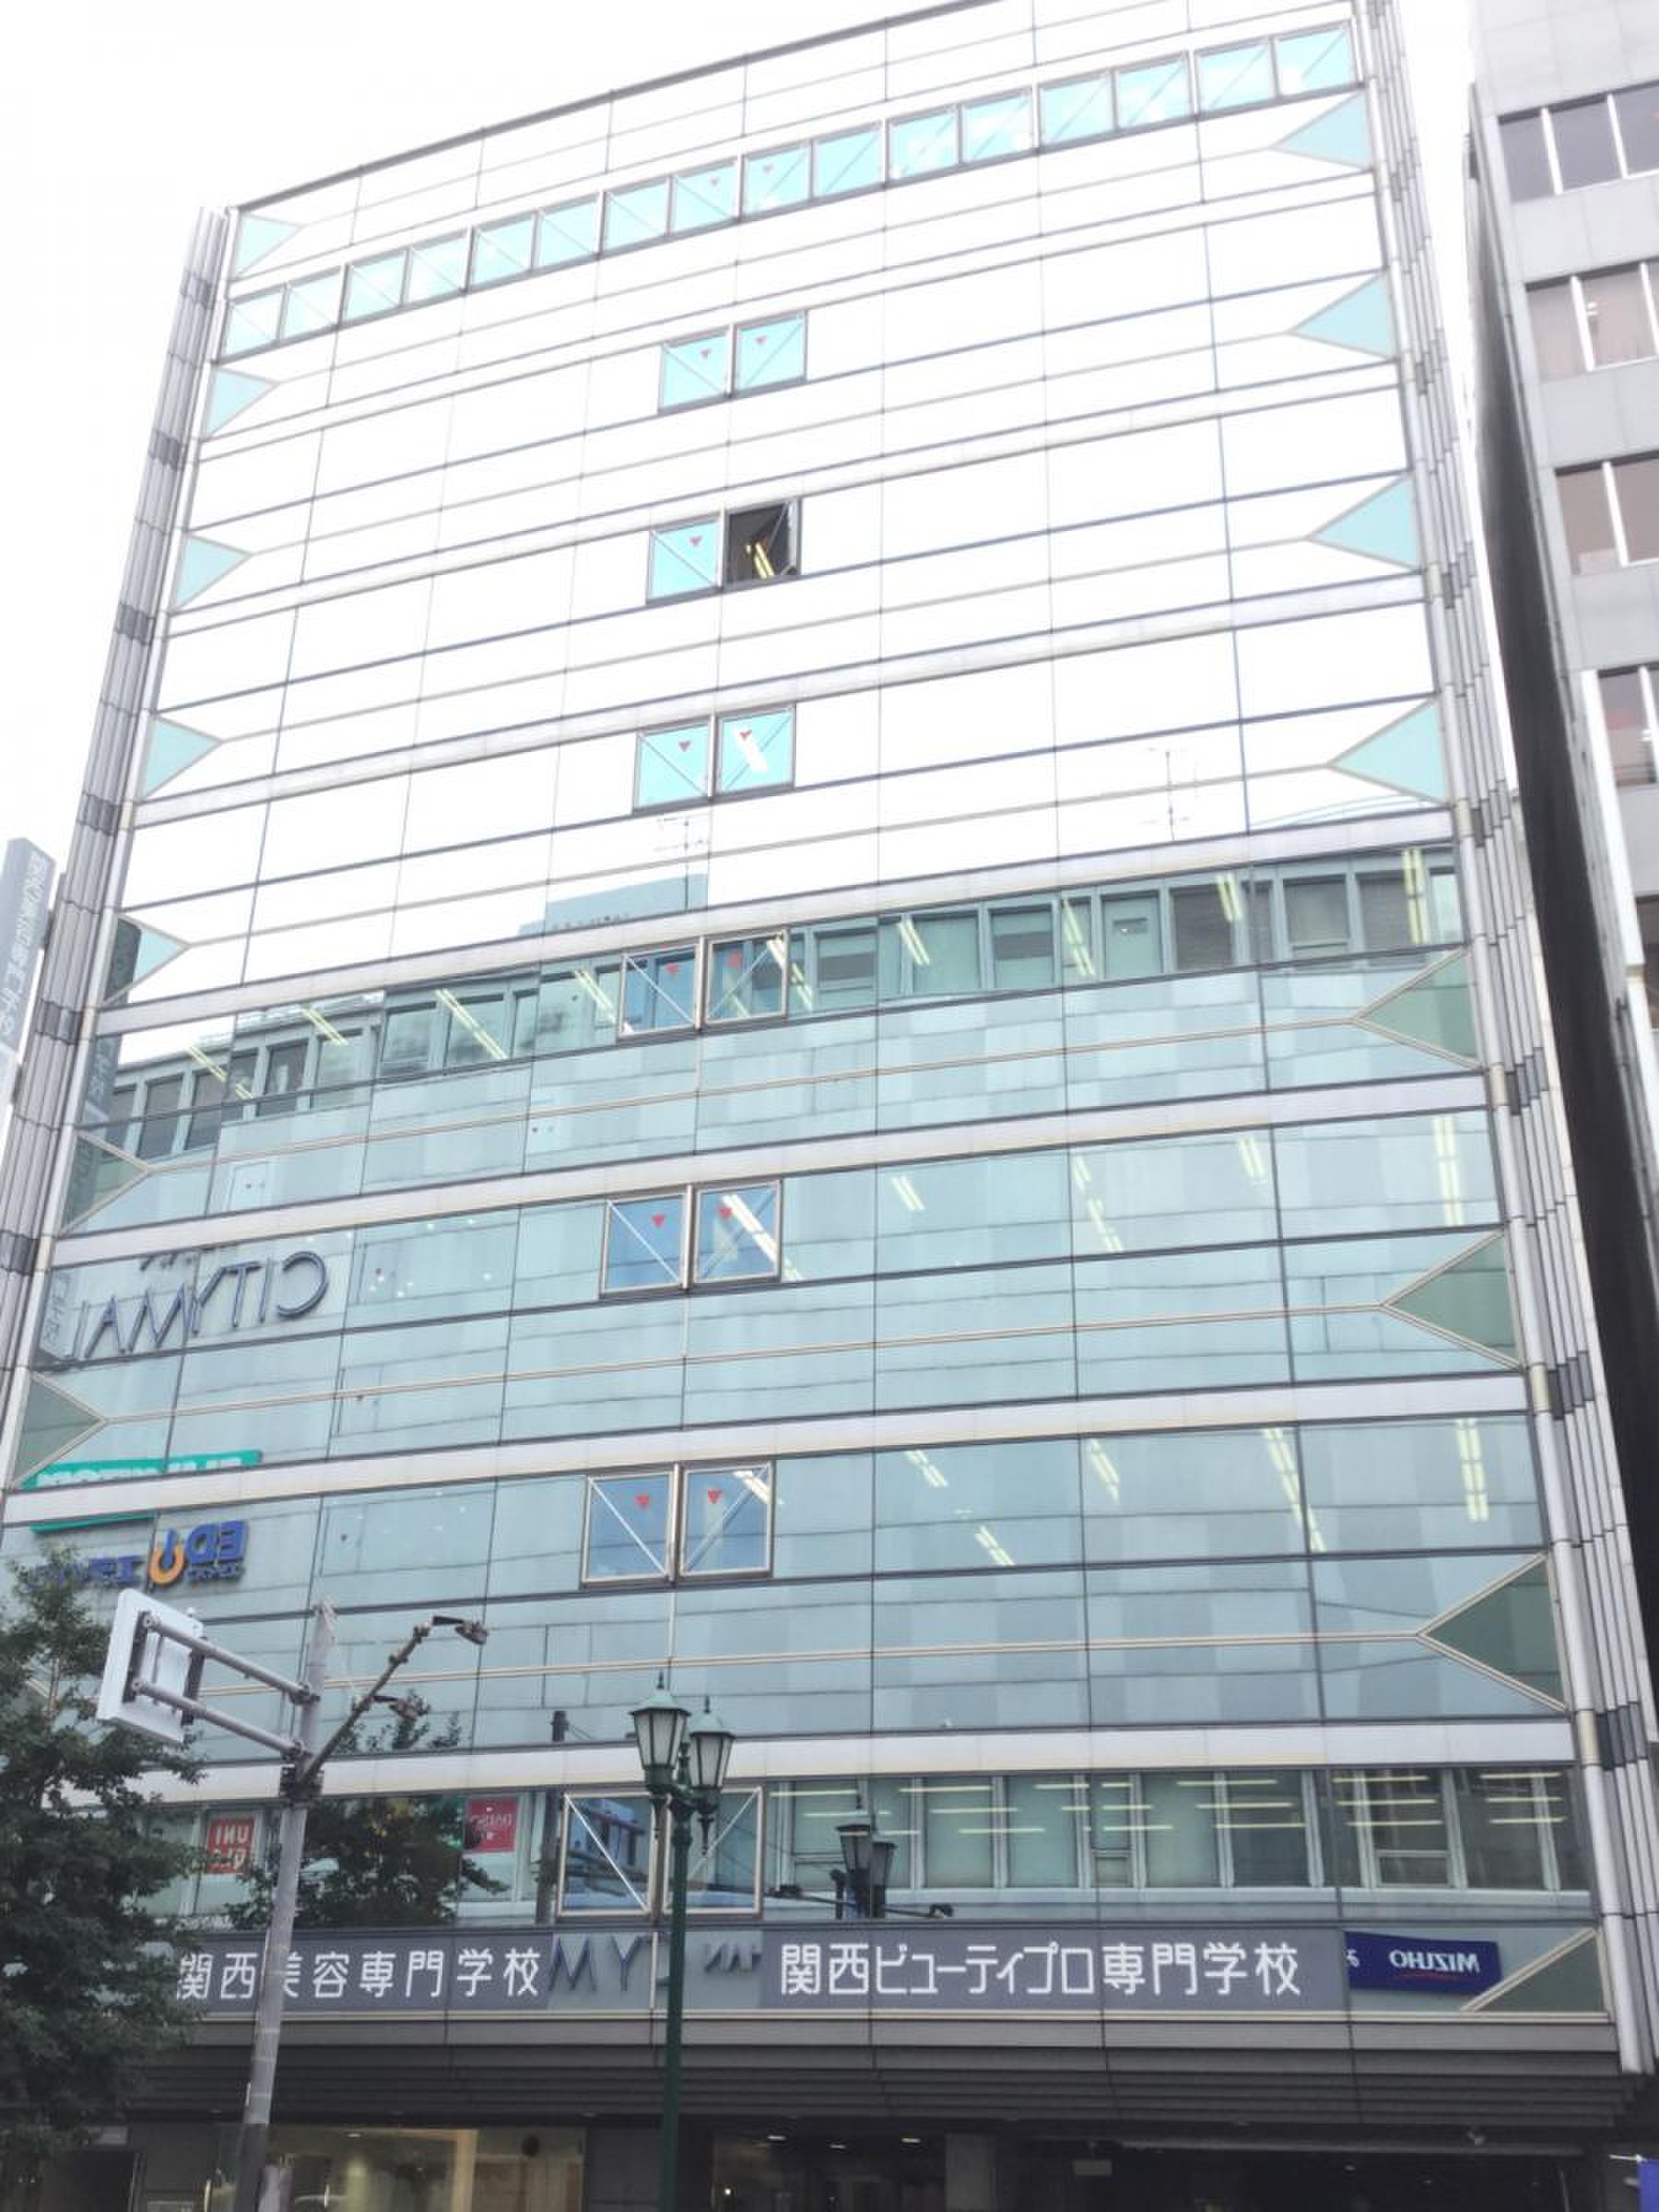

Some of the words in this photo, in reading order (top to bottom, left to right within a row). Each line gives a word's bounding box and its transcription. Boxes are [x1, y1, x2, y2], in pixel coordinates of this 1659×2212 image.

[780, 1940, 1302, 1997] 関西ビューティプロ専門学校
